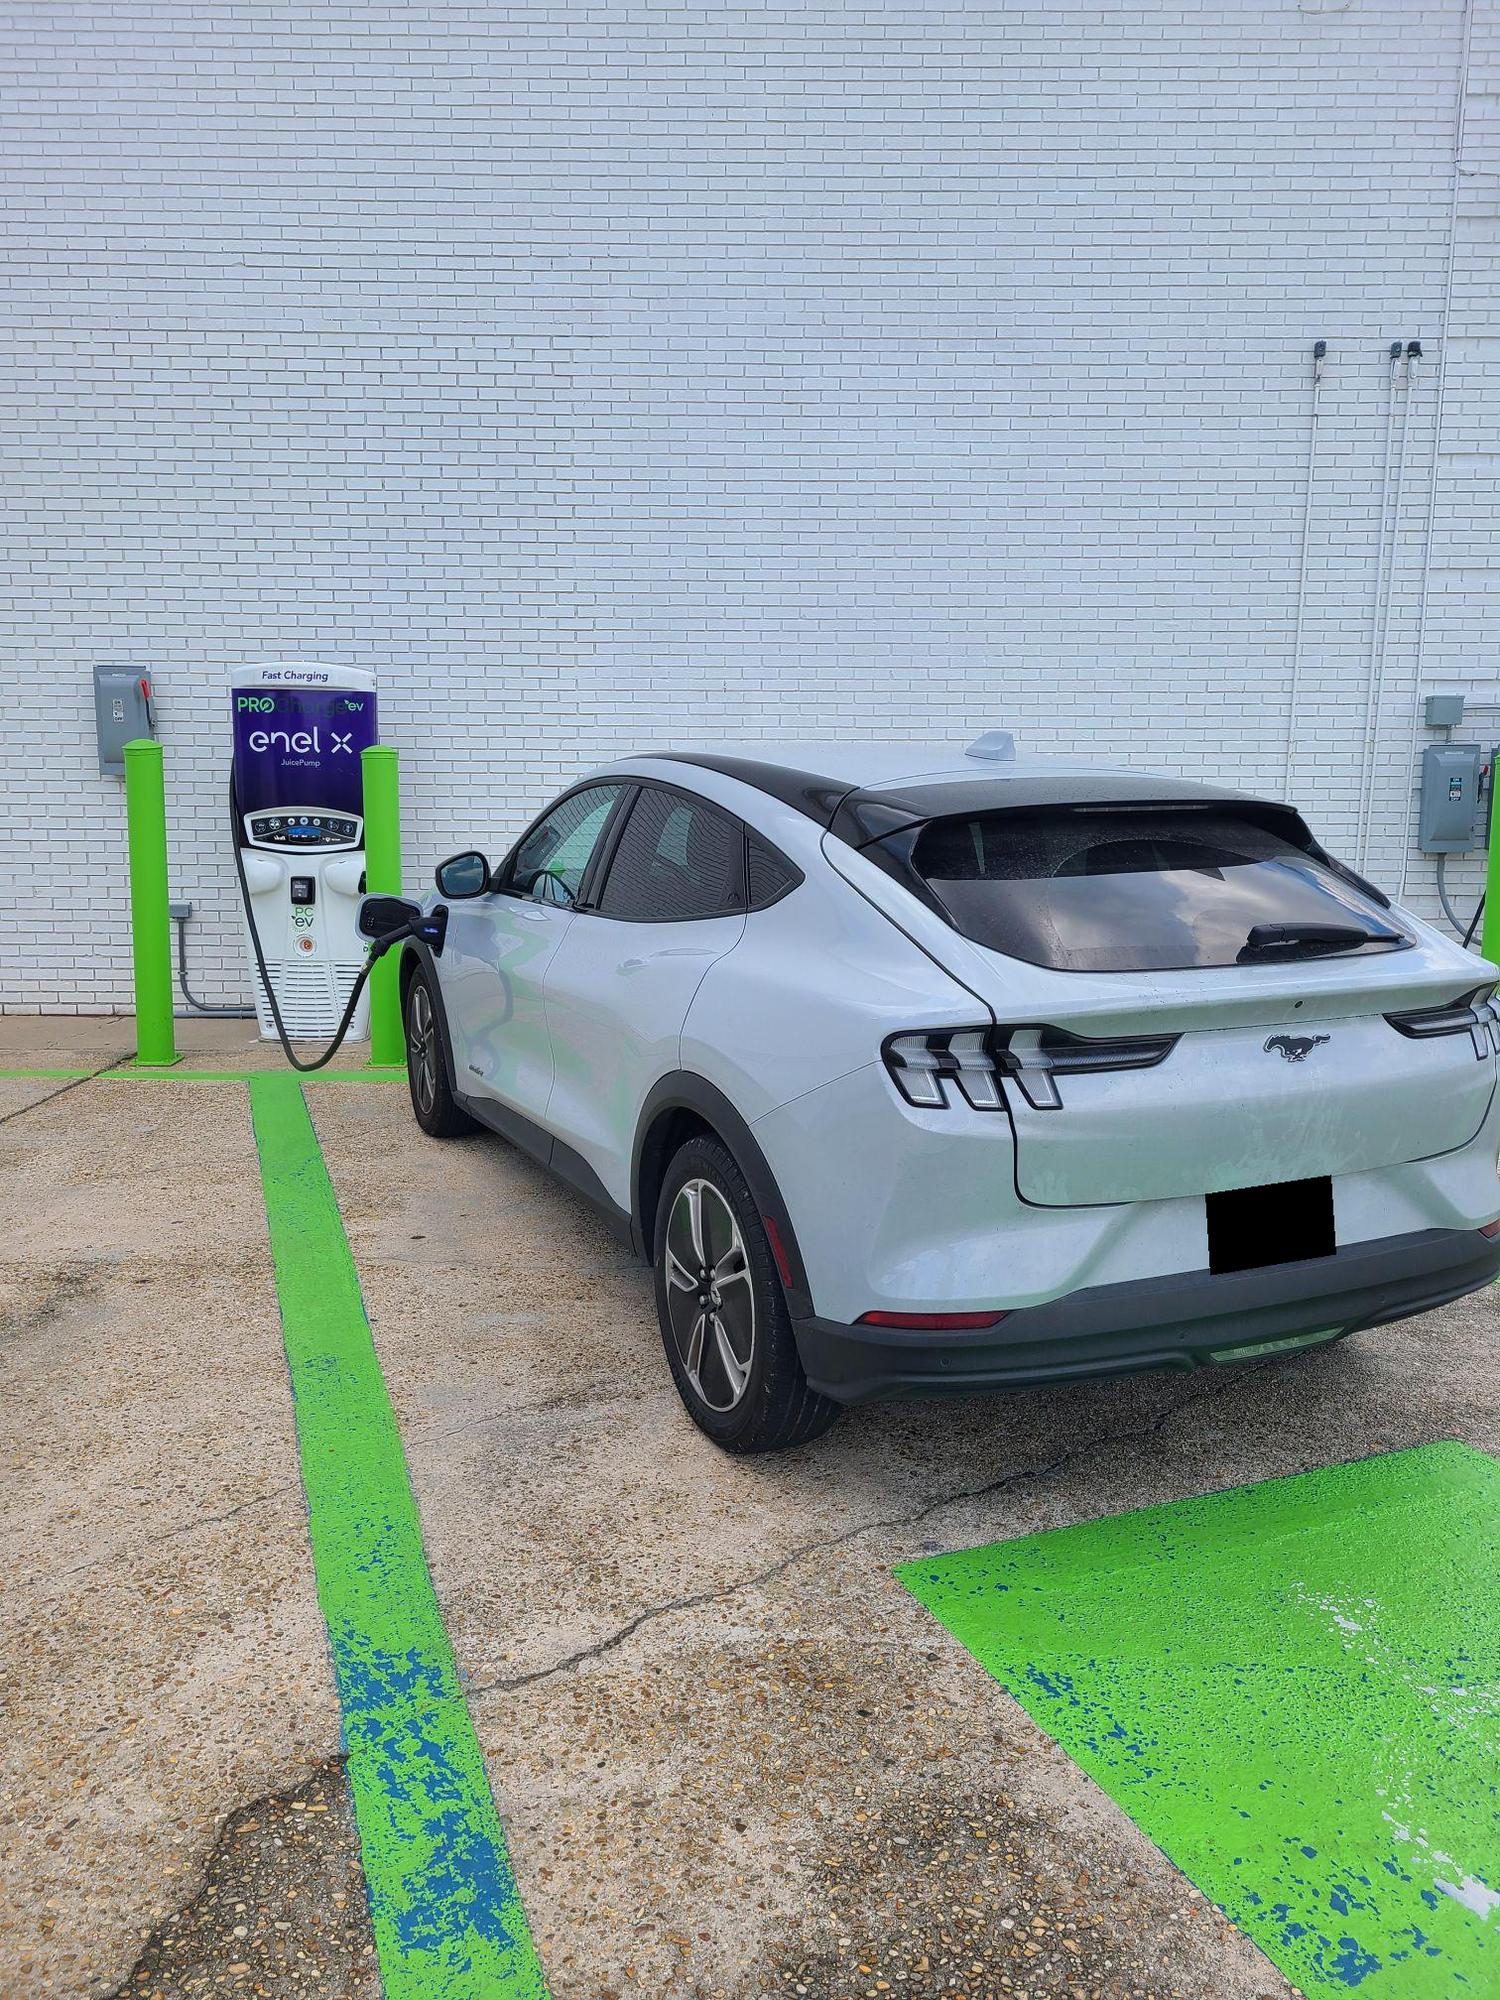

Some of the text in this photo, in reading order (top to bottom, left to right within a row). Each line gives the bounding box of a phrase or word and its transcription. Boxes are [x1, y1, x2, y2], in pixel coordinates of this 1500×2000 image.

[262, 670, 329, 683] Fast Charging
[248, 726, 321, 754] enel
[280, 758, 321, 768] JuicePump
[295, 907, 314, 917] PC
[295, 917, 314, 928] ev
